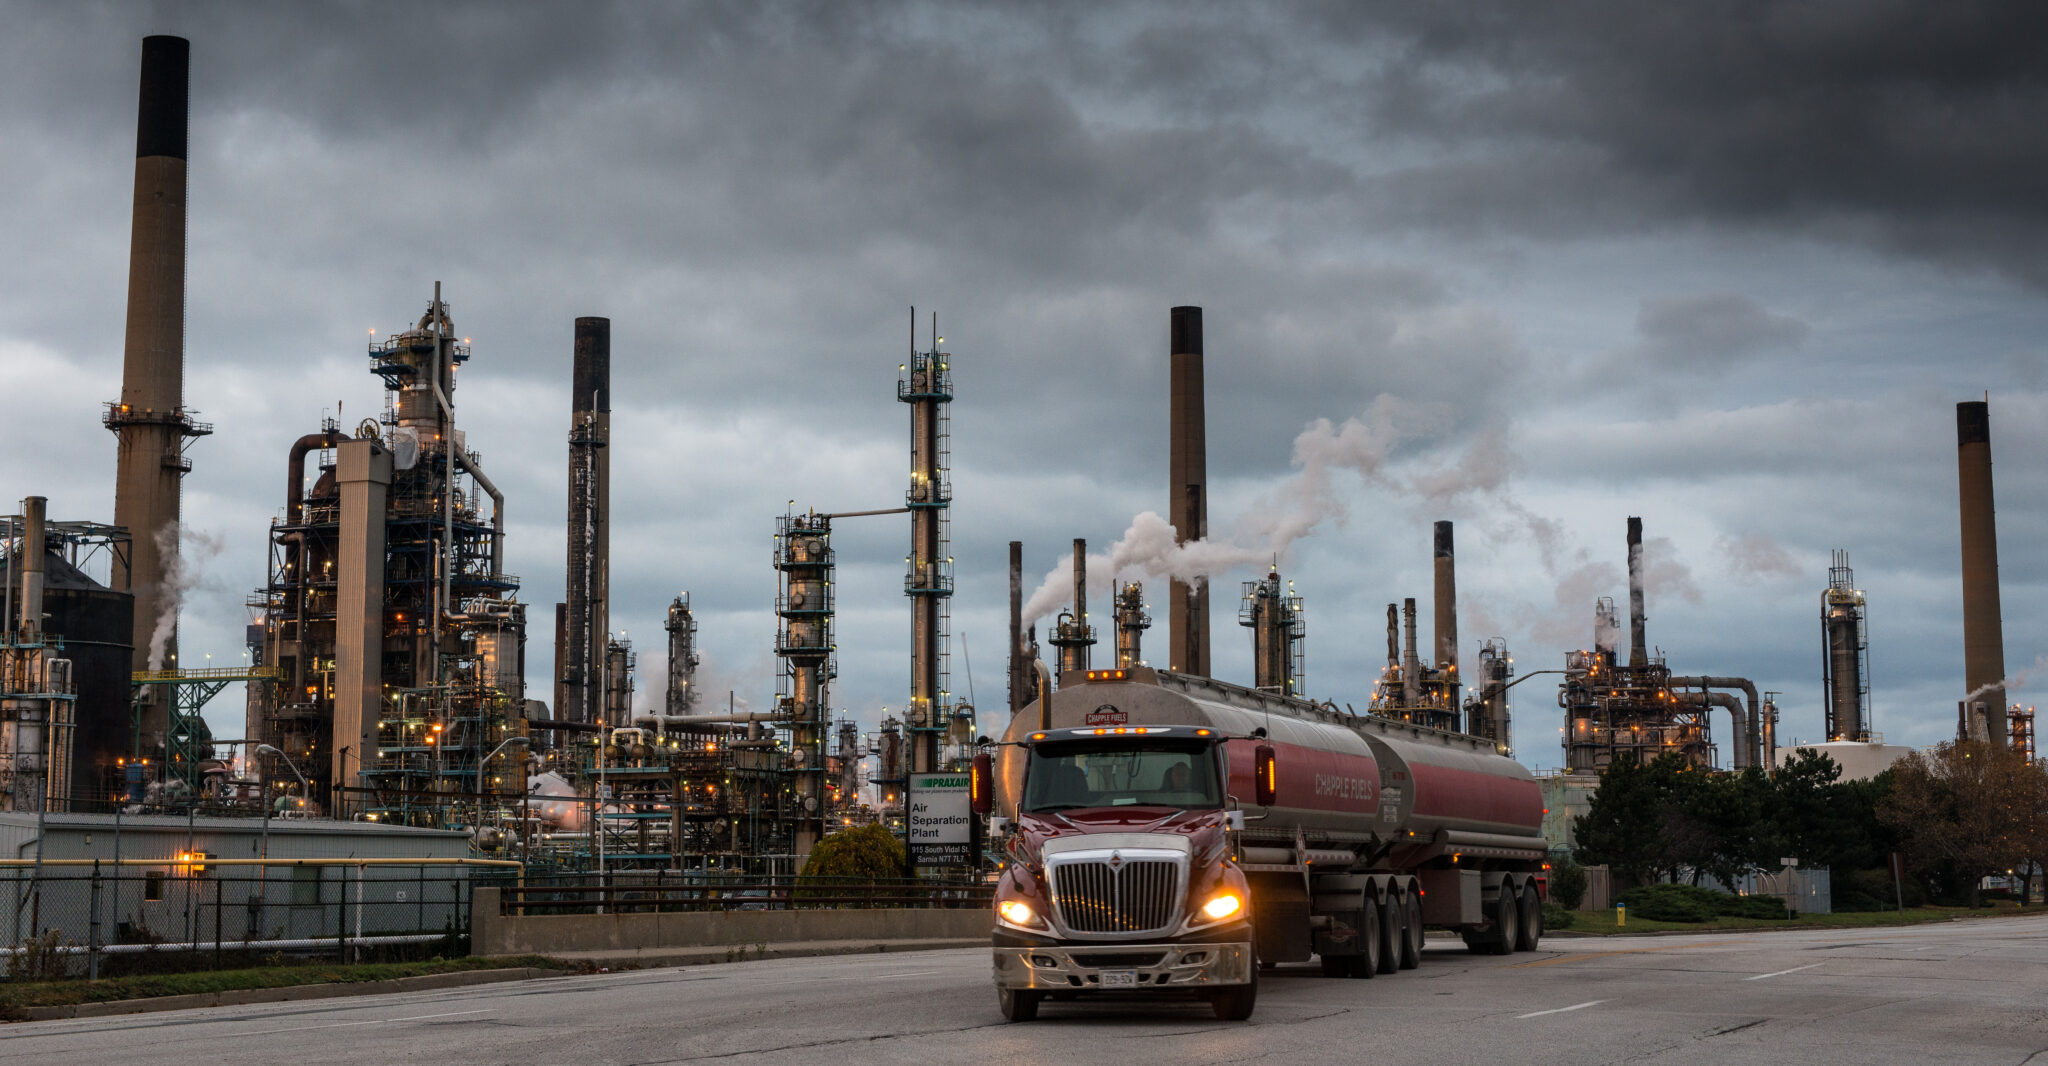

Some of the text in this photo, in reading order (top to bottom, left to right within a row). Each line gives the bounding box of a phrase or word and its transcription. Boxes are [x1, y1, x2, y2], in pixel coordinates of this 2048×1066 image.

[1088, 713, 1126, 723] CHAPPLE FUELS
[933, 778, 969, 787] PRAXAIR
[1315, 773, 1349, 799] CHAPPLE
[1351, 778, 1373, 800] FUELS
[912, 803, 928, 812] Air
[912, 816, 969, 827] Separation
[912, 828, 939, 837] Plant
[917, 855, 938, 863] Sarnia
